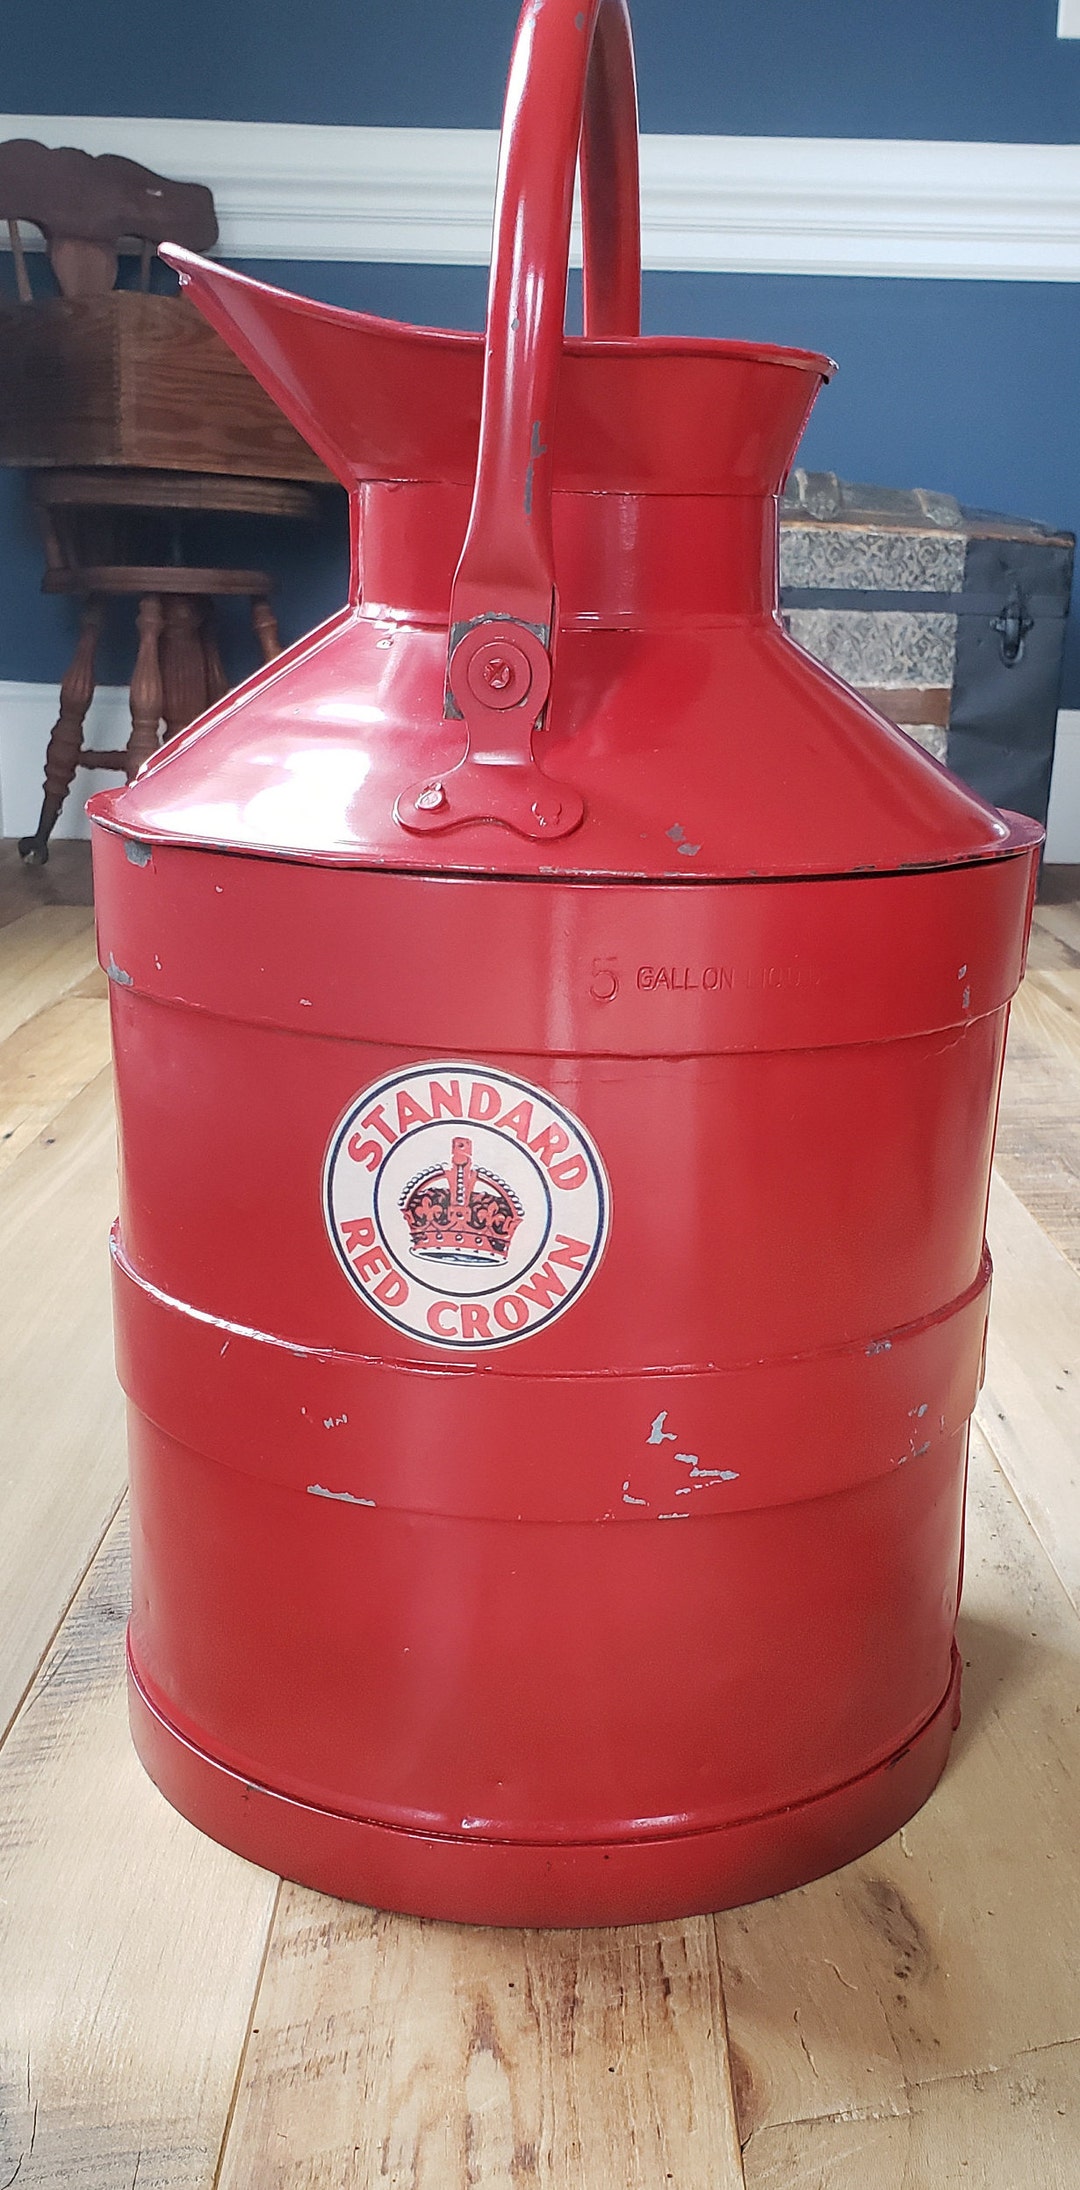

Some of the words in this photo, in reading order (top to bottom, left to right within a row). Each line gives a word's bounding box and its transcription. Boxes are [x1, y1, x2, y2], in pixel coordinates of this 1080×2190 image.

[589, 956, 620, 1003] 5
[636, 965, 736, 992] GALLON
[347, 1080, 588, 1191] STANDARD
[340, 1217, 409, 1307] RED
[426, 1234, 591, 1339] CROWN
